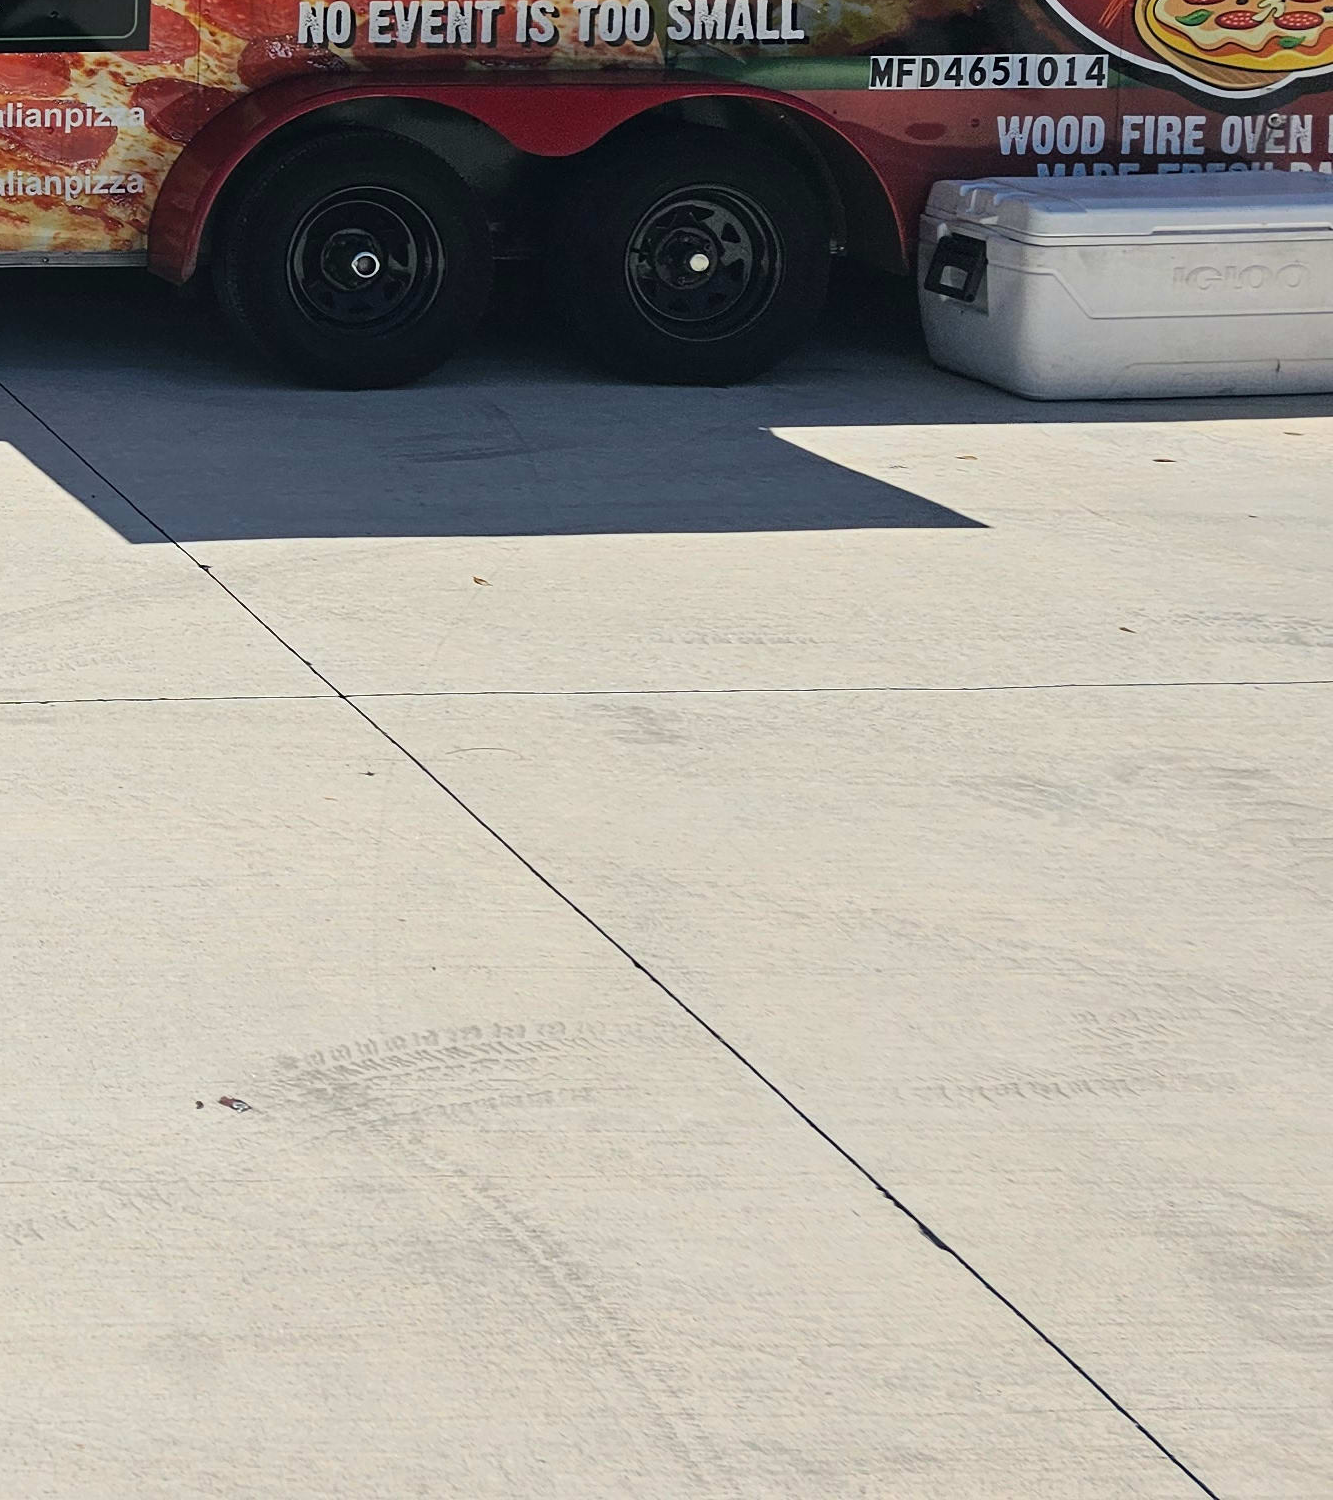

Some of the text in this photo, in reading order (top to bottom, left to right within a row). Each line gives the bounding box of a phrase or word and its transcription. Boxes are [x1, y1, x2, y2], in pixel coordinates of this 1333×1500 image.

[298, 1, 351, 44] NO
[369, 1, 504, 44] EVENT
[517, 1, 556, 43] IS
[578, 0, 649, 43] TOO
[869, 56, 1106, 88] MFD4651014
[997, 114, 1106, 155] WOOD
[1121, 115, 1206, 155] FIRE
[1220, 114, 1313, 154] OVEN
[1172, 263, 1311, 291] IGLOO
